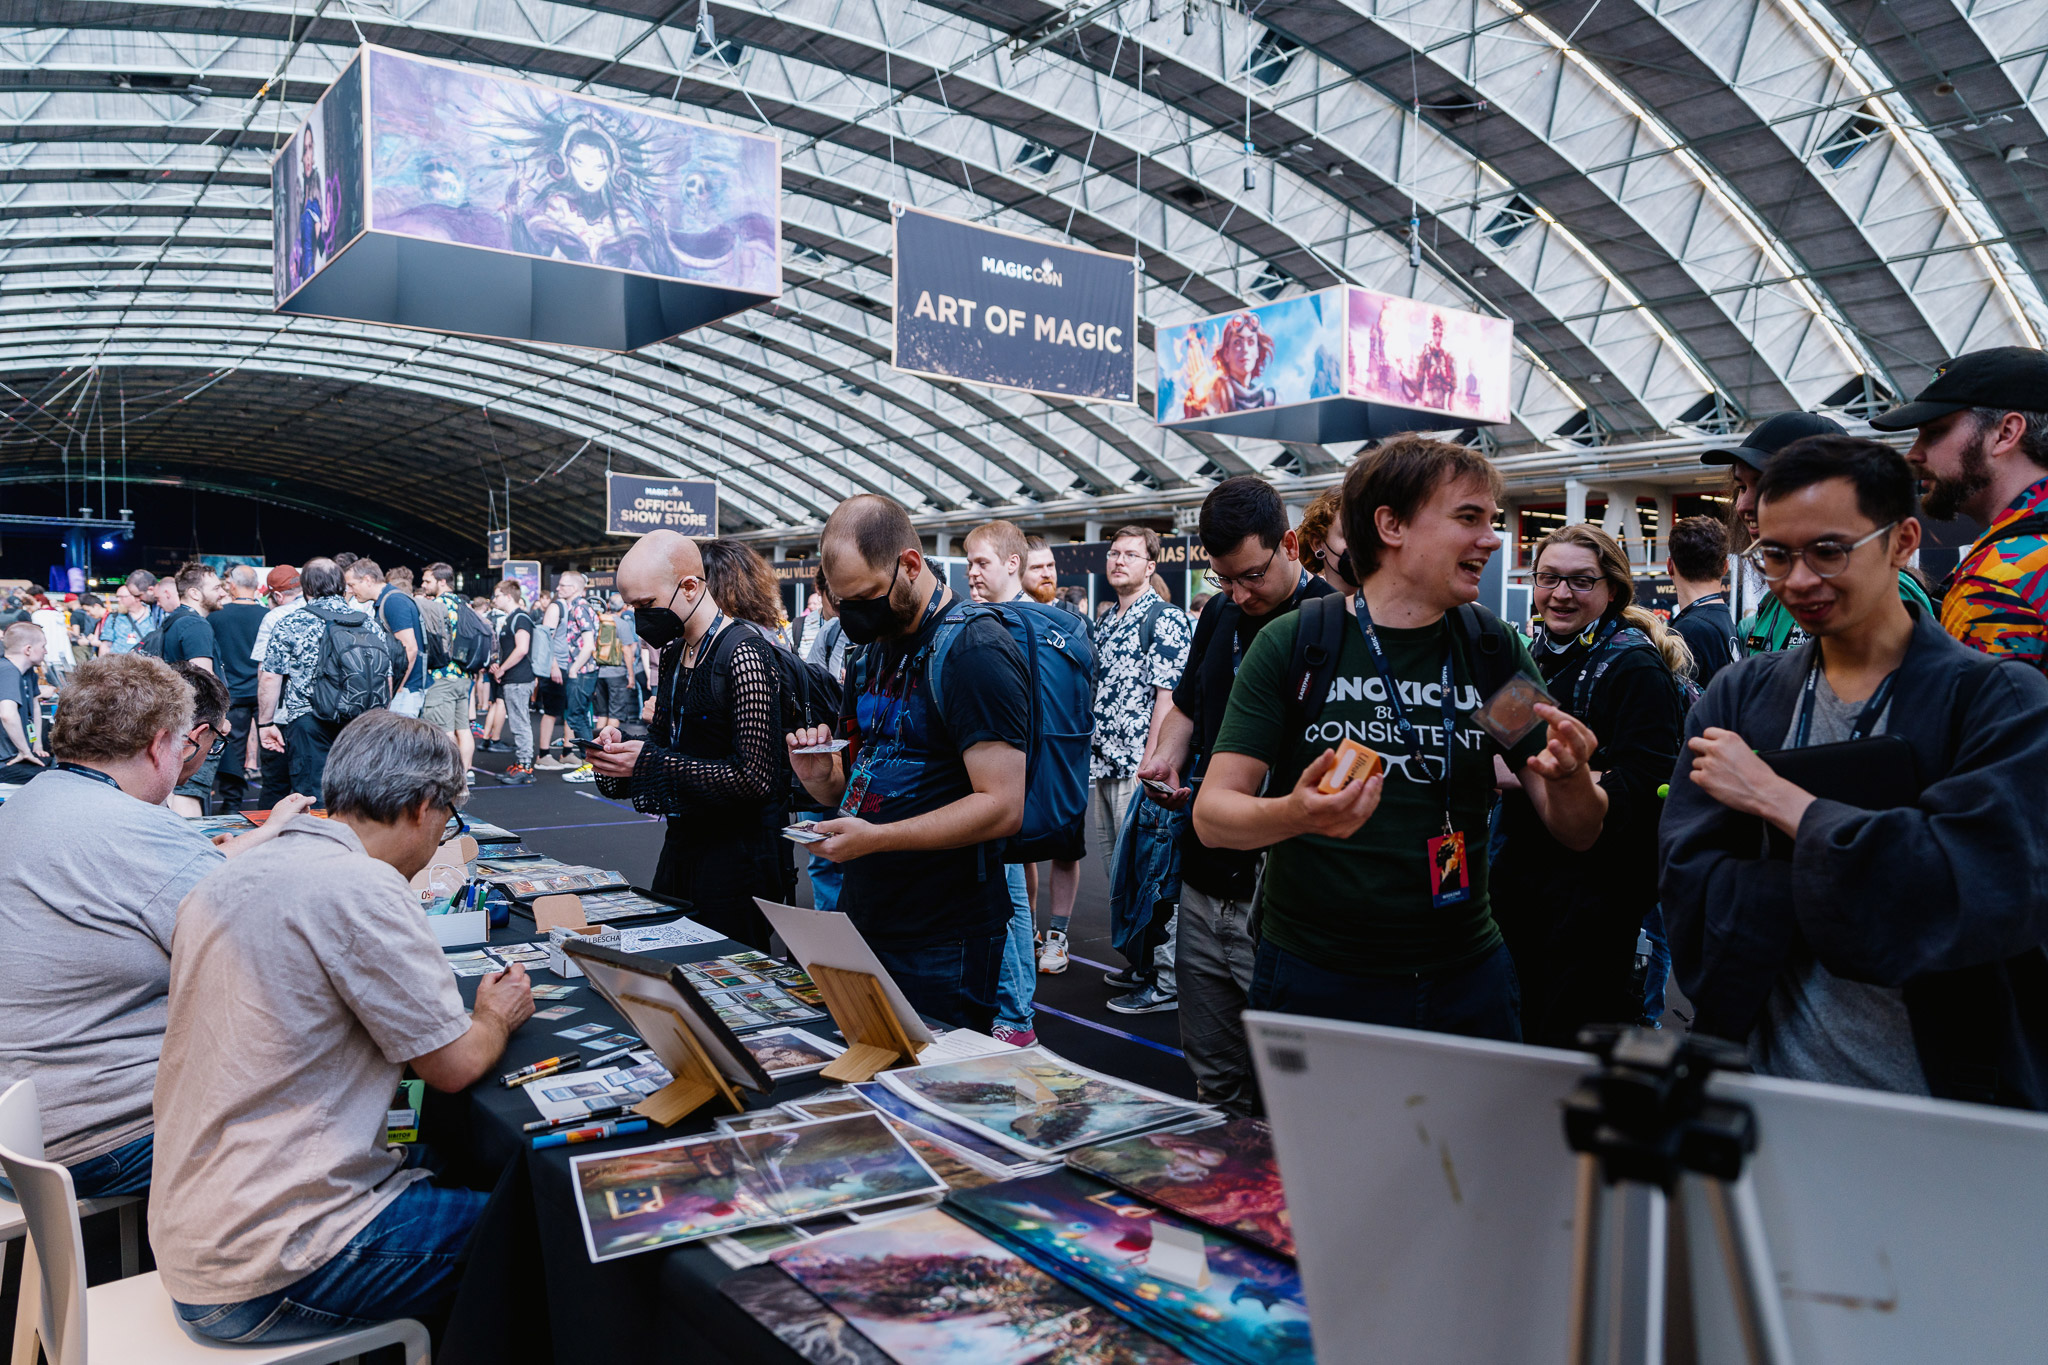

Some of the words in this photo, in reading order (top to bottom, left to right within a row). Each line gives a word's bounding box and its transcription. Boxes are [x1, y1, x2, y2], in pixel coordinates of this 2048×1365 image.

[914, 290, 977, 328] ART
[984, 304, 1027, 337] OF
[1034, 313, 1123, 354] MAGIC
[634, 497, 695, 513] OFFICIAL
[620, 509, 662, 525] SHOW
[664, 513, 707, 527] STORE
[772, 567, 793, 580] GALI
[1655, 585, 1677, 594] WIZ
[1297, 670, 1312, 702] EASTPAK
